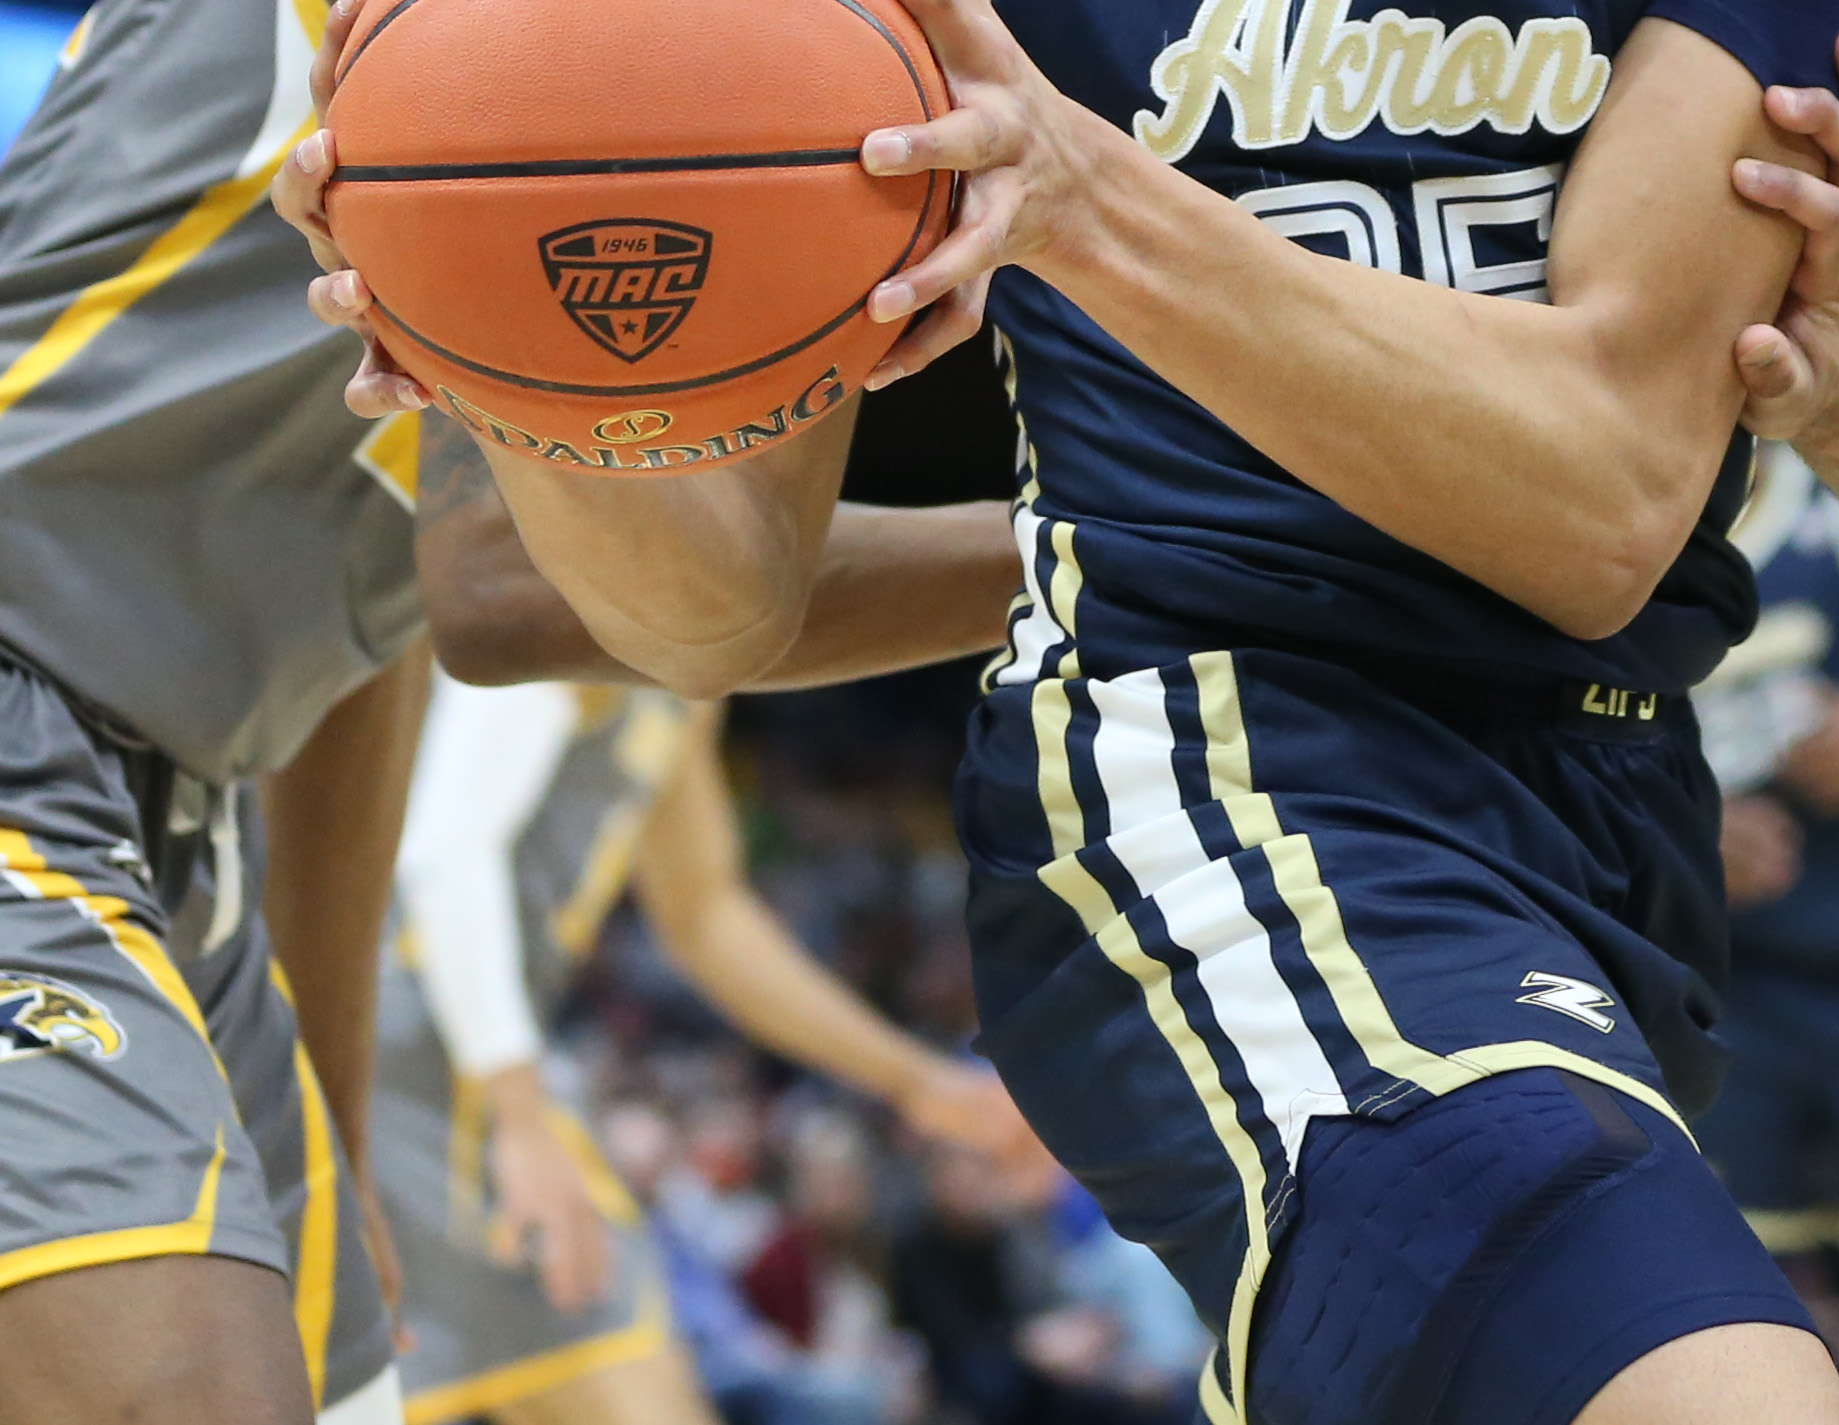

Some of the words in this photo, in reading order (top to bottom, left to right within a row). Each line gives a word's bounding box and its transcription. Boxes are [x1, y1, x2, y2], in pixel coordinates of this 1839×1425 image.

[601, 237, 648, 254] 1946
[554, 263, 702, 305] MAC
[436, 364, 846, 470] SPALDING
